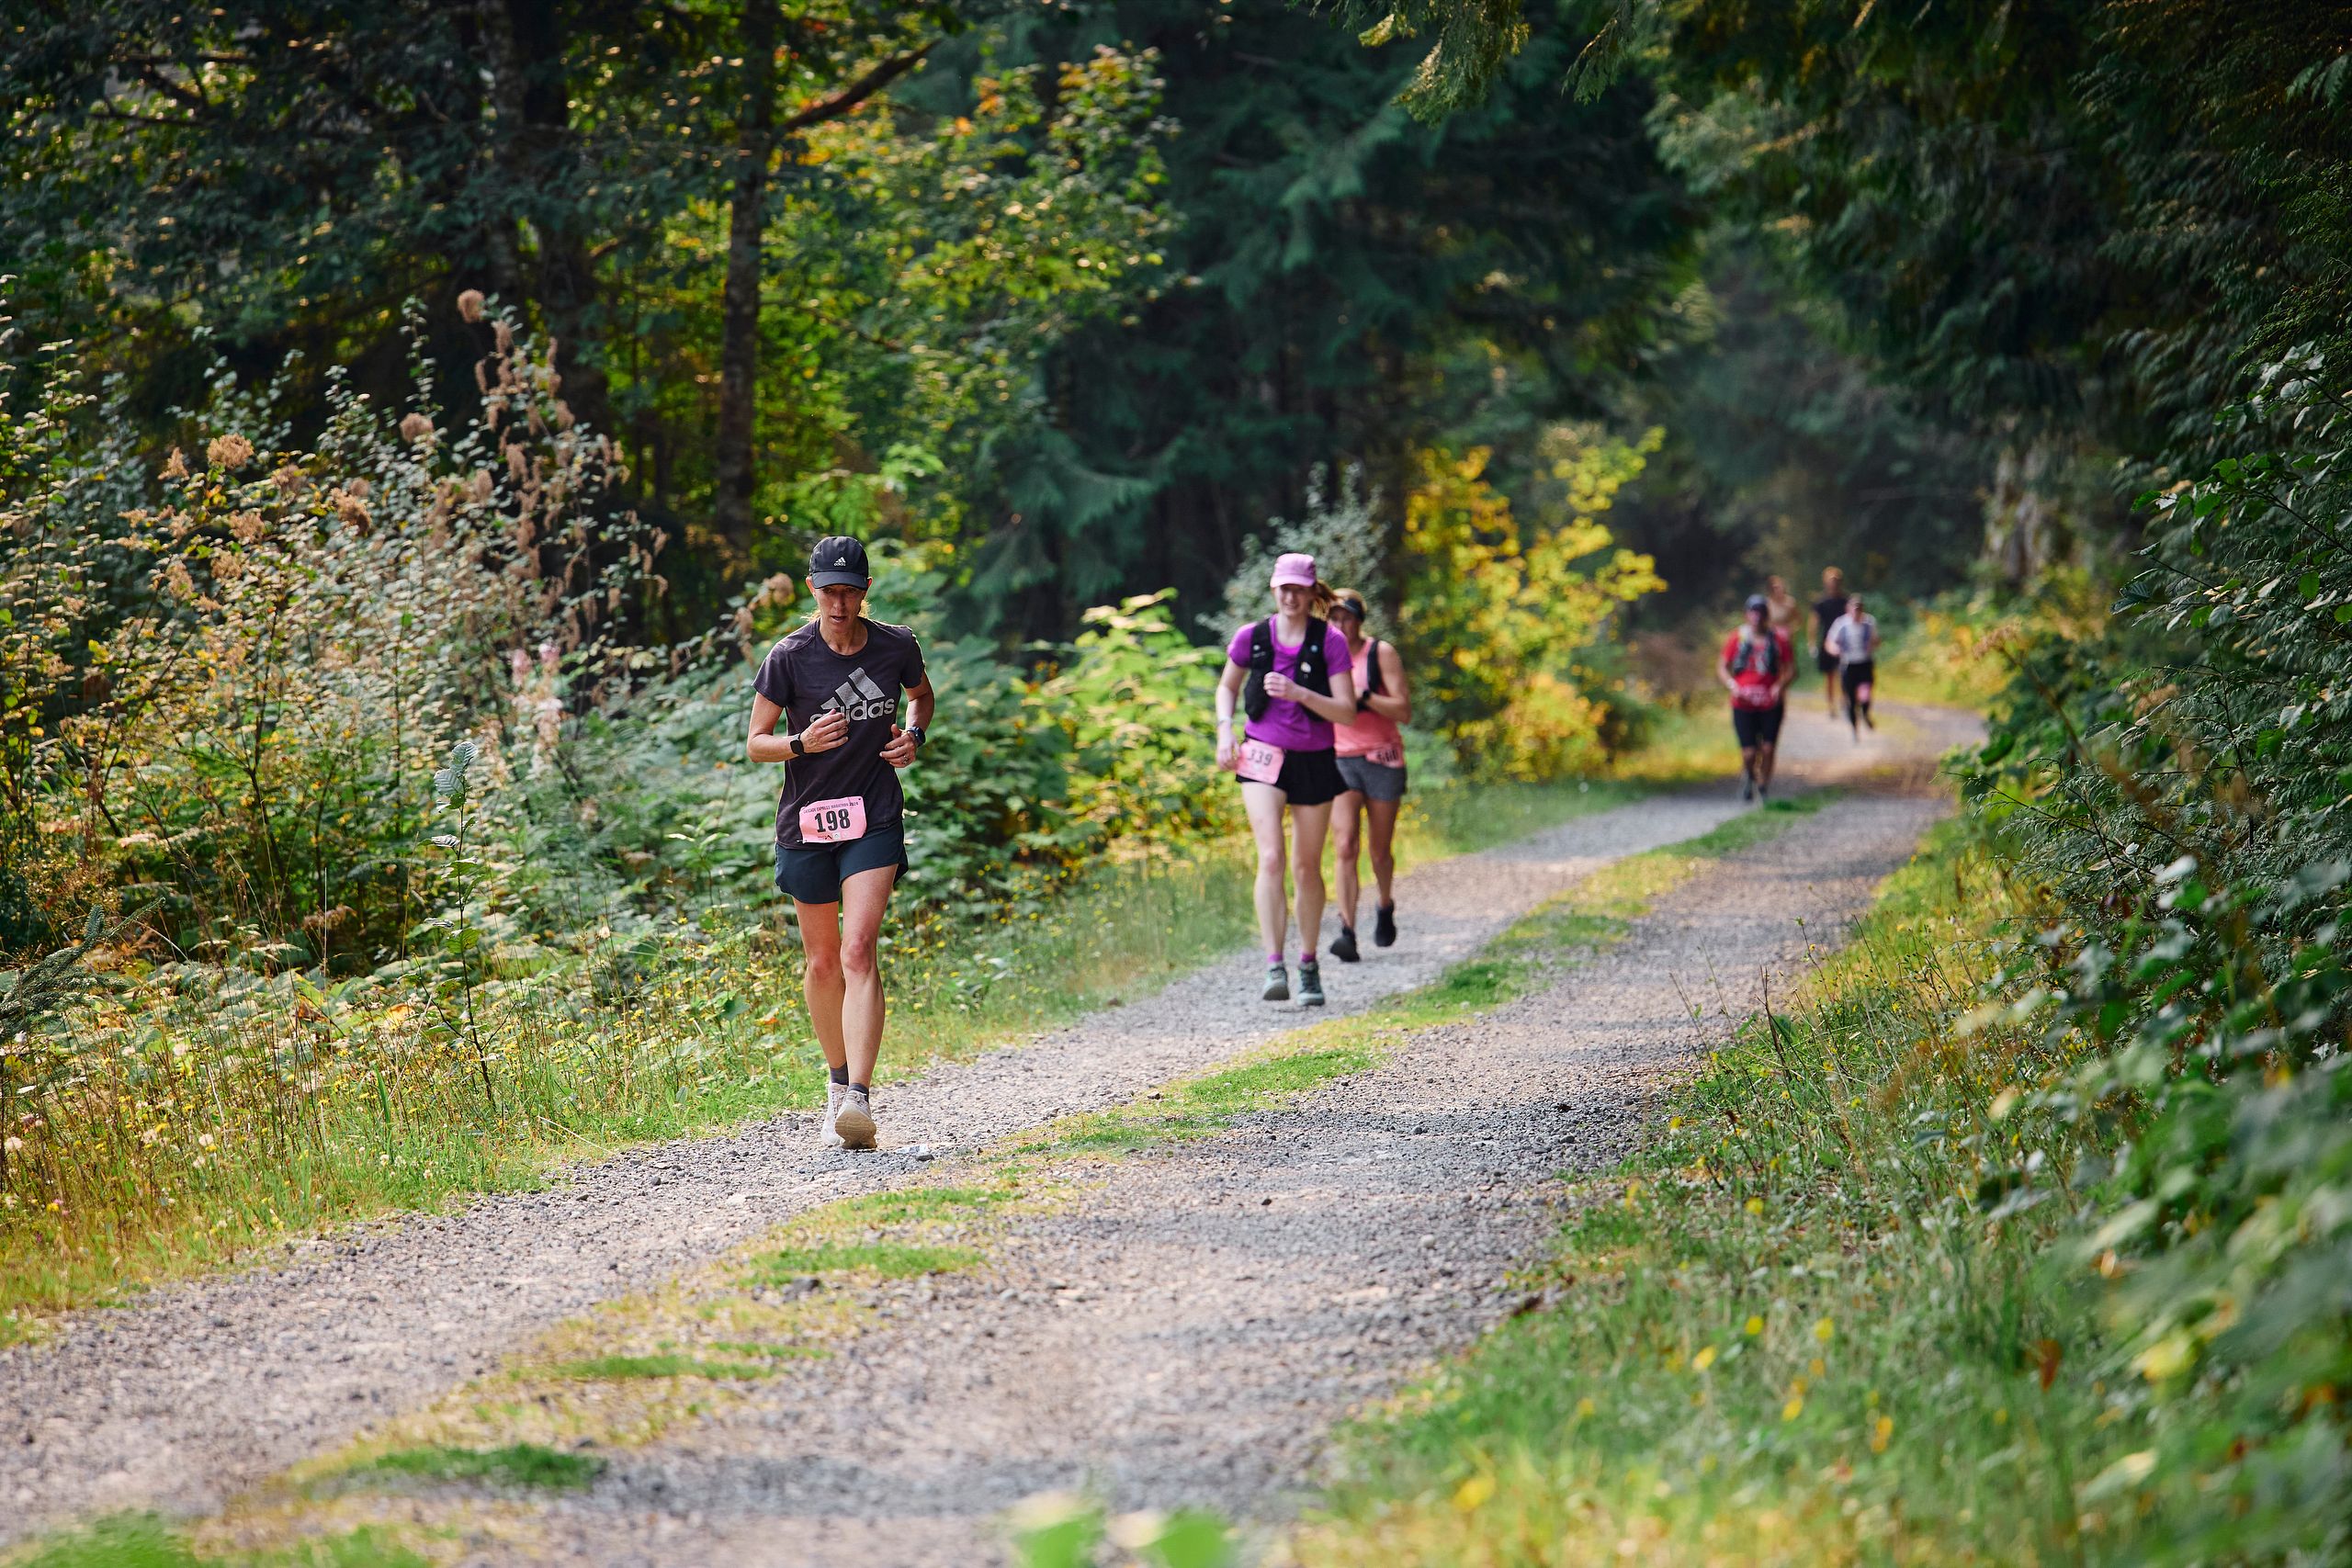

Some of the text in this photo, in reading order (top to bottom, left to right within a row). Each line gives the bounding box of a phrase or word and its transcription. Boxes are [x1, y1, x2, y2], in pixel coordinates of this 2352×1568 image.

[809, 698, 895, 724] idas
[1247, 749, 1272, 766] 339
[814, 808, 851, 833] 198
